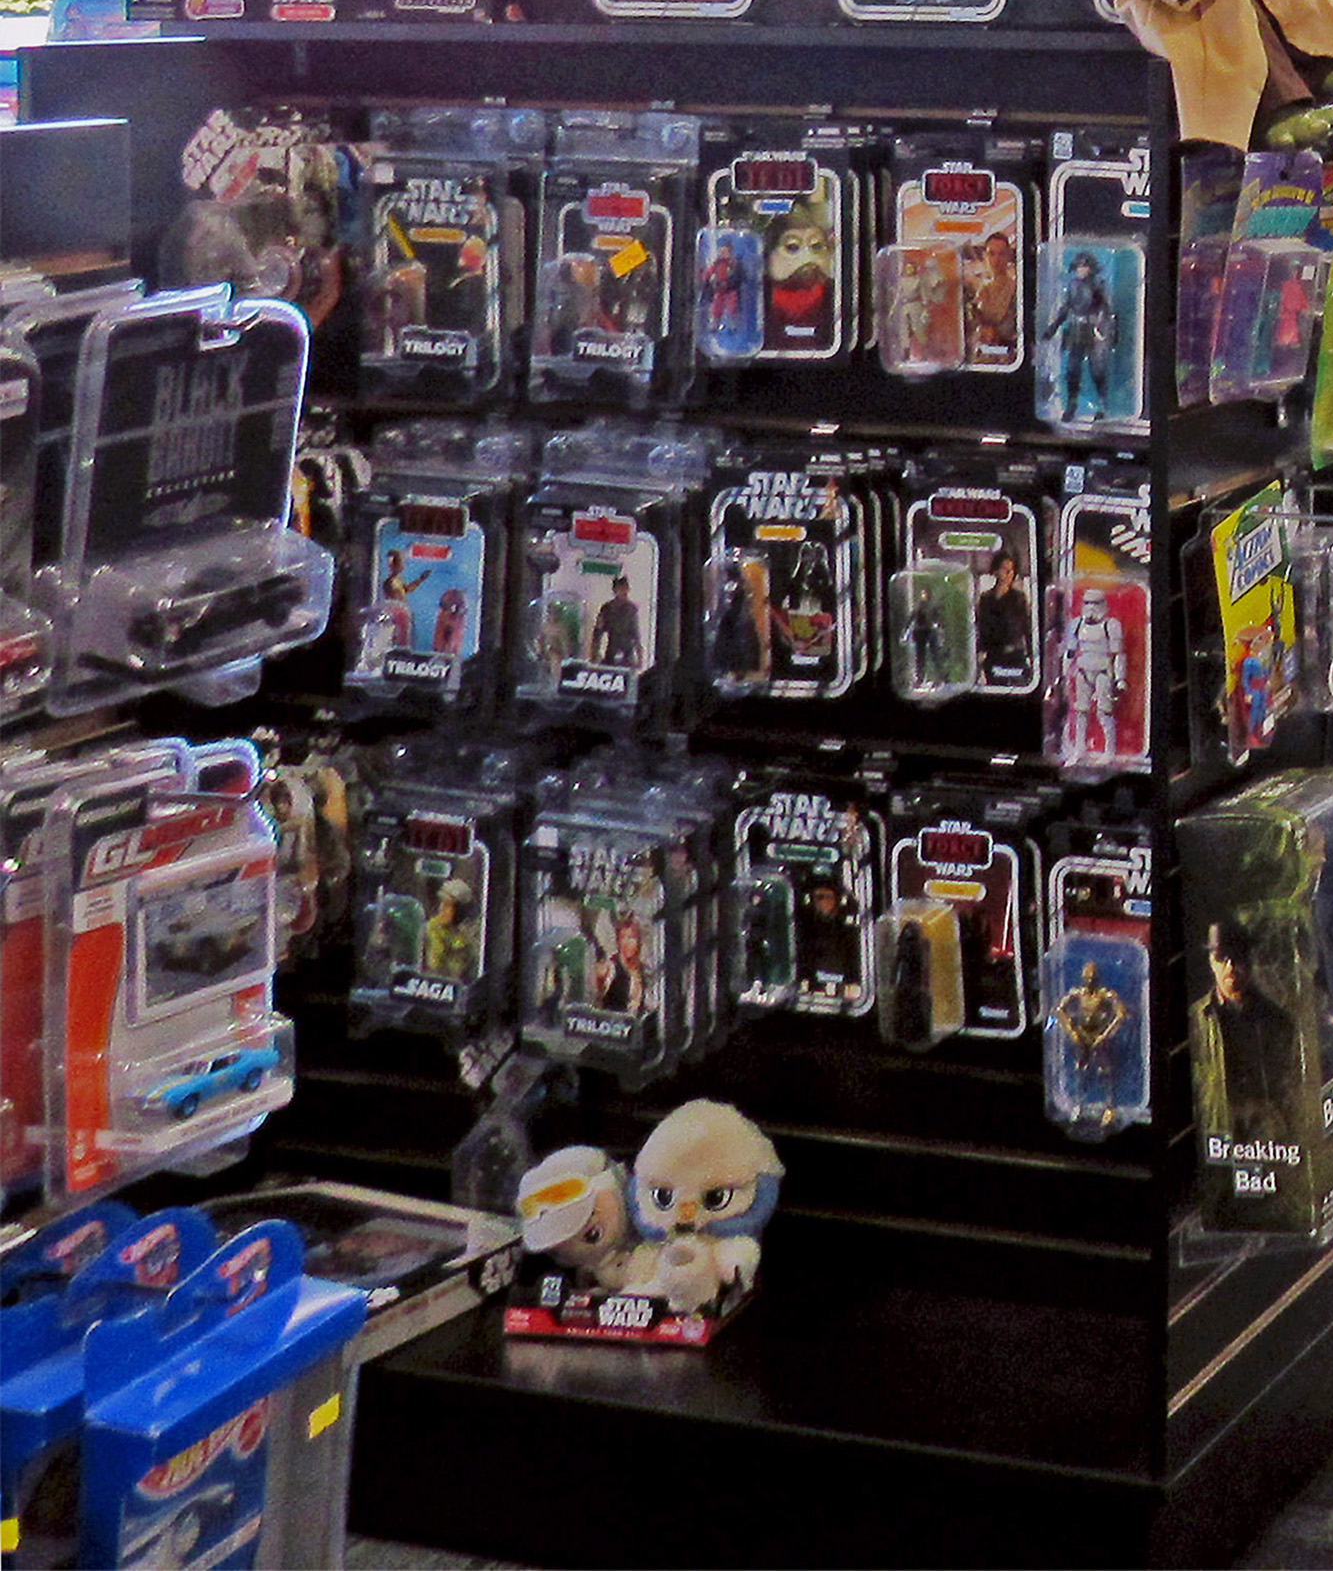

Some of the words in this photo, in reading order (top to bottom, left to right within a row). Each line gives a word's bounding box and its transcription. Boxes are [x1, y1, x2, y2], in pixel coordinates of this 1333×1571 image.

[943, 161, 973, 172] STAR
[938, 201, 978, 214] WARS
[403, 339, 467, 358] TRILOGY
[577, 341, 643, 359] TRILOGY
[386, 658, 451, 678] TRILOGY
[563, 672, 625, 693] SAGA
[939, 819, 971, 834] STAR
[935, 861, 974, 877] WARS
[394, 979, 455, 1002] SAGA
[567, 1016, 632, 1038] TRILOGY
[1208, 1134, 1301, 1165] Breaking
[1234, 1168, 1277, 1194] Bad
[606, 1296, 651, 1310] STAR
[598, 1306, 654, 1328] WARS
